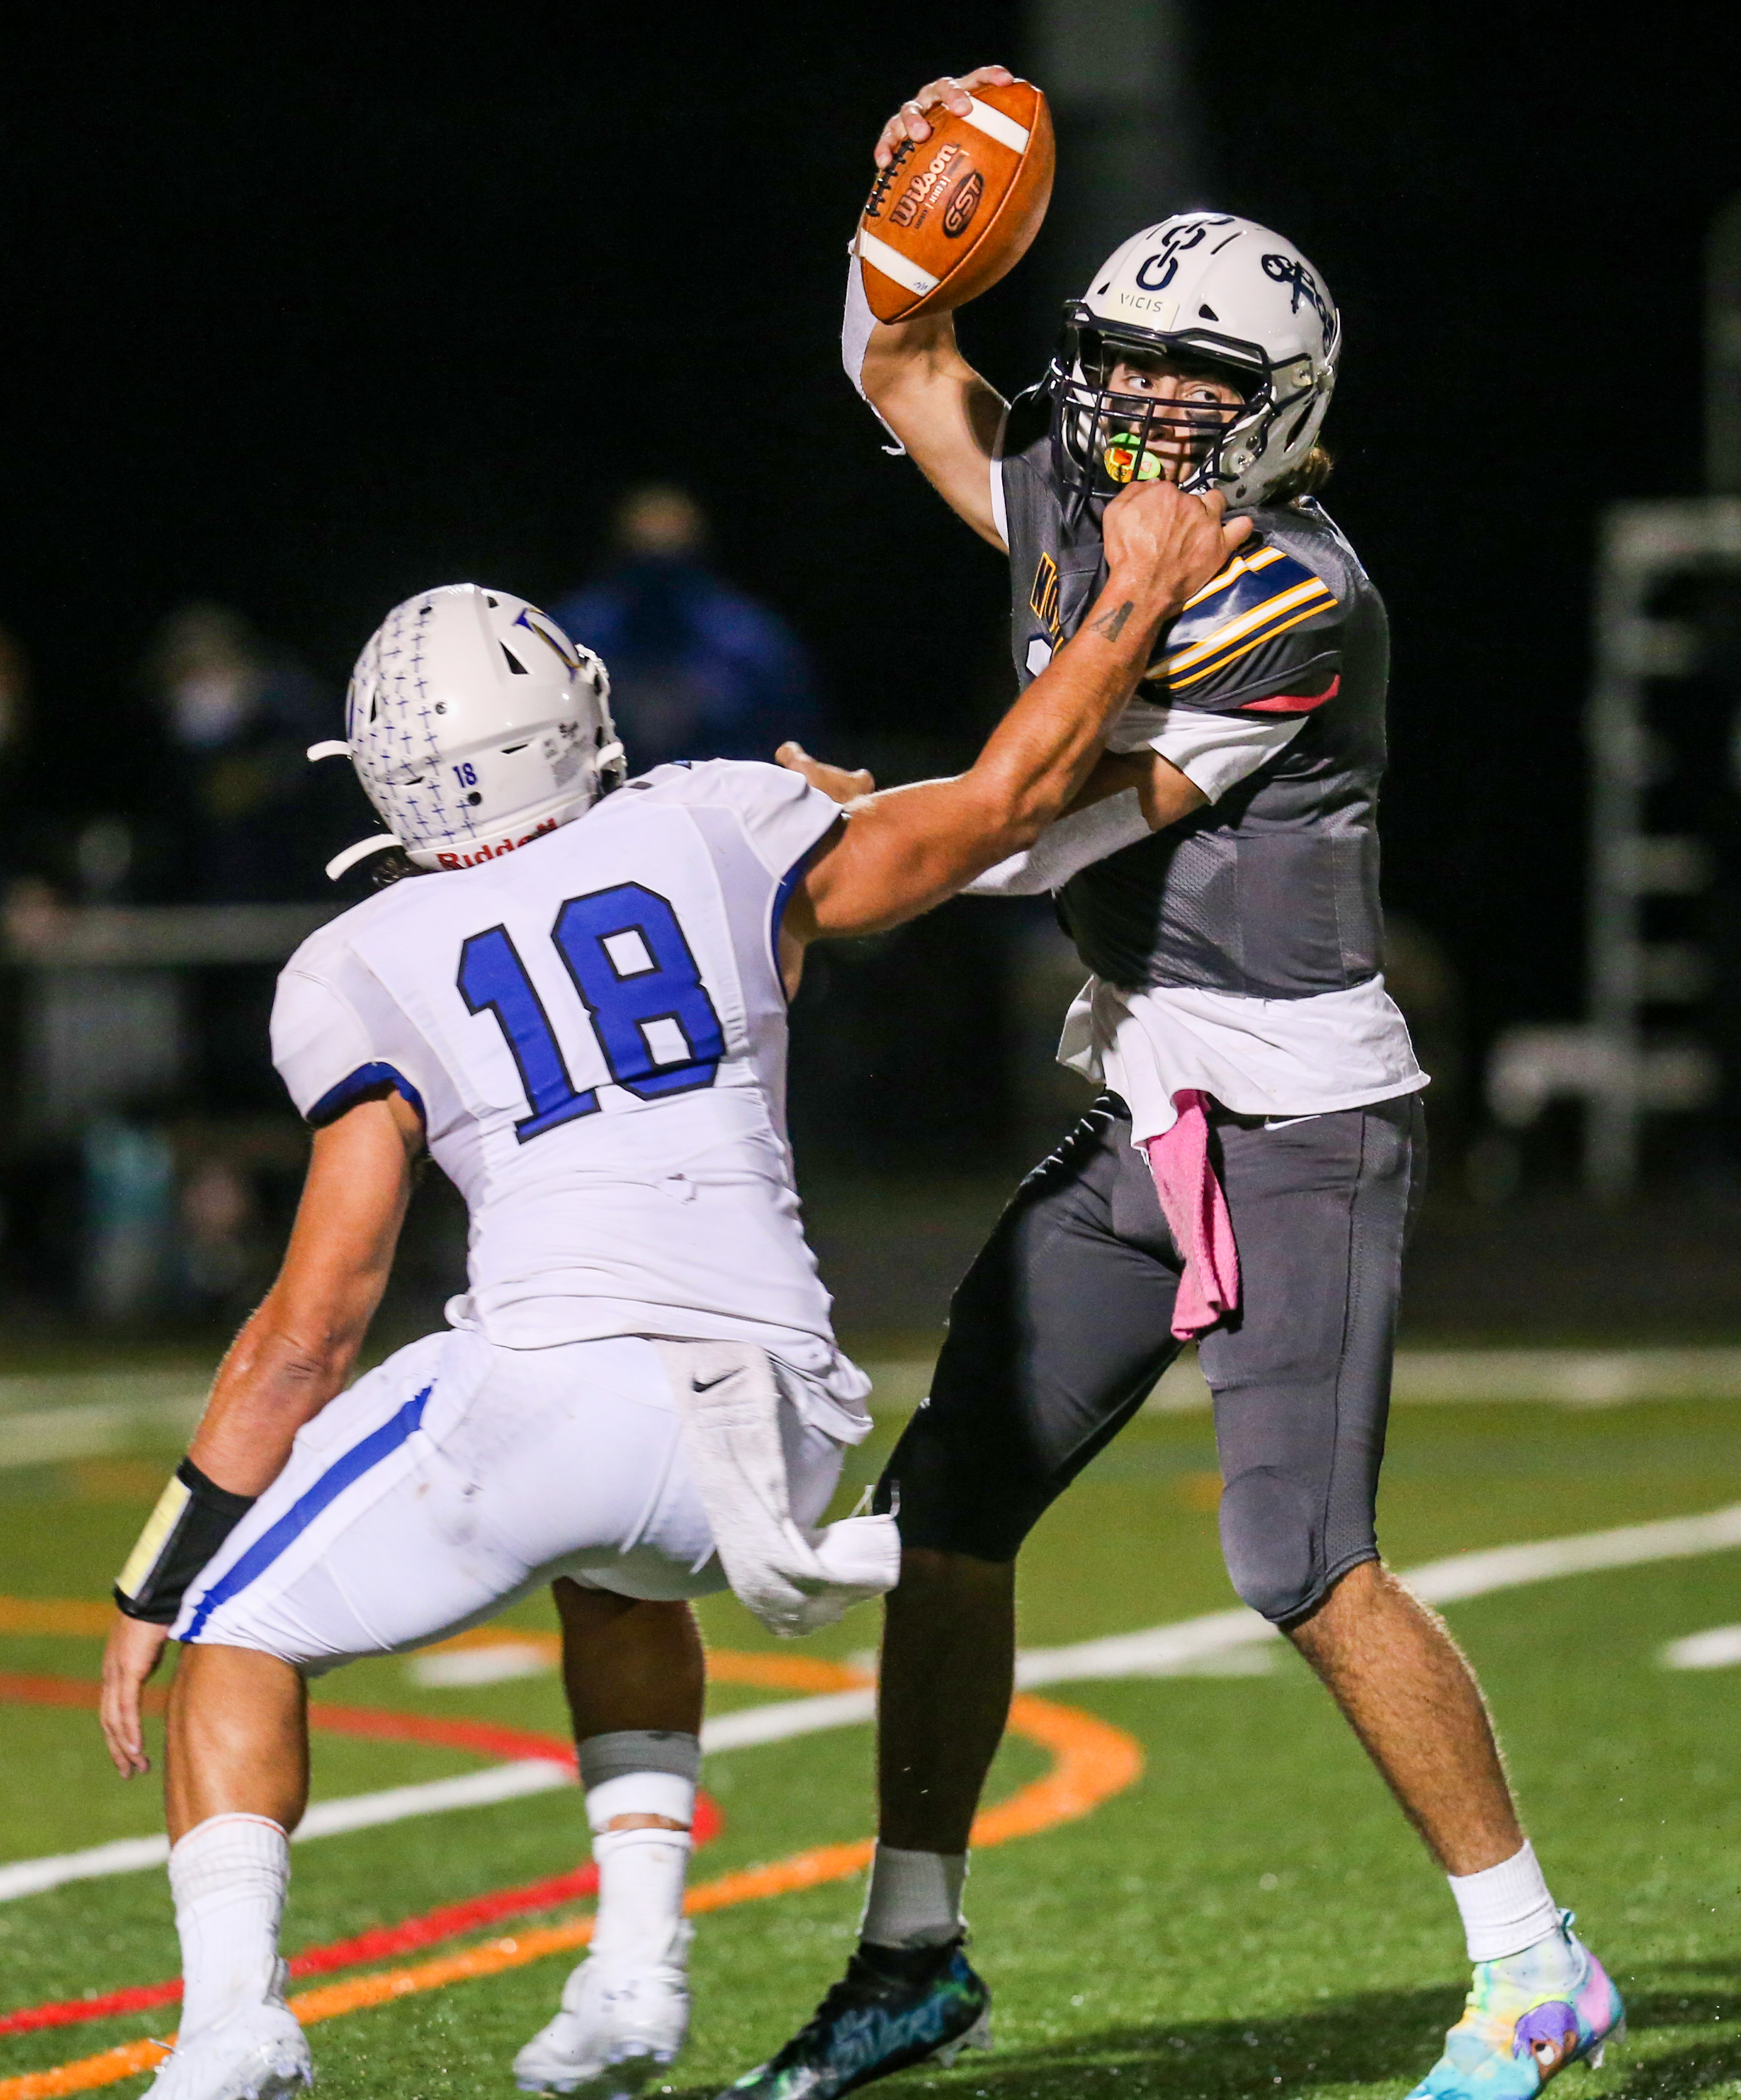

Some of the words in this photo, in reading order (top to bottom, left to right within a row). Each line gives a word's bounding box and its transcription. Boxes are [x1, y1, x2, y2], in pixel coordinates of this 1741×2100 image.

[889, 144, 958, 227] Wilson
[945, 173, 980, 231] GST
[1121, 293, 1163, 312] VICIS
[452, 763, 477, 789] 18
[455, 880, 727, 1145] 18
